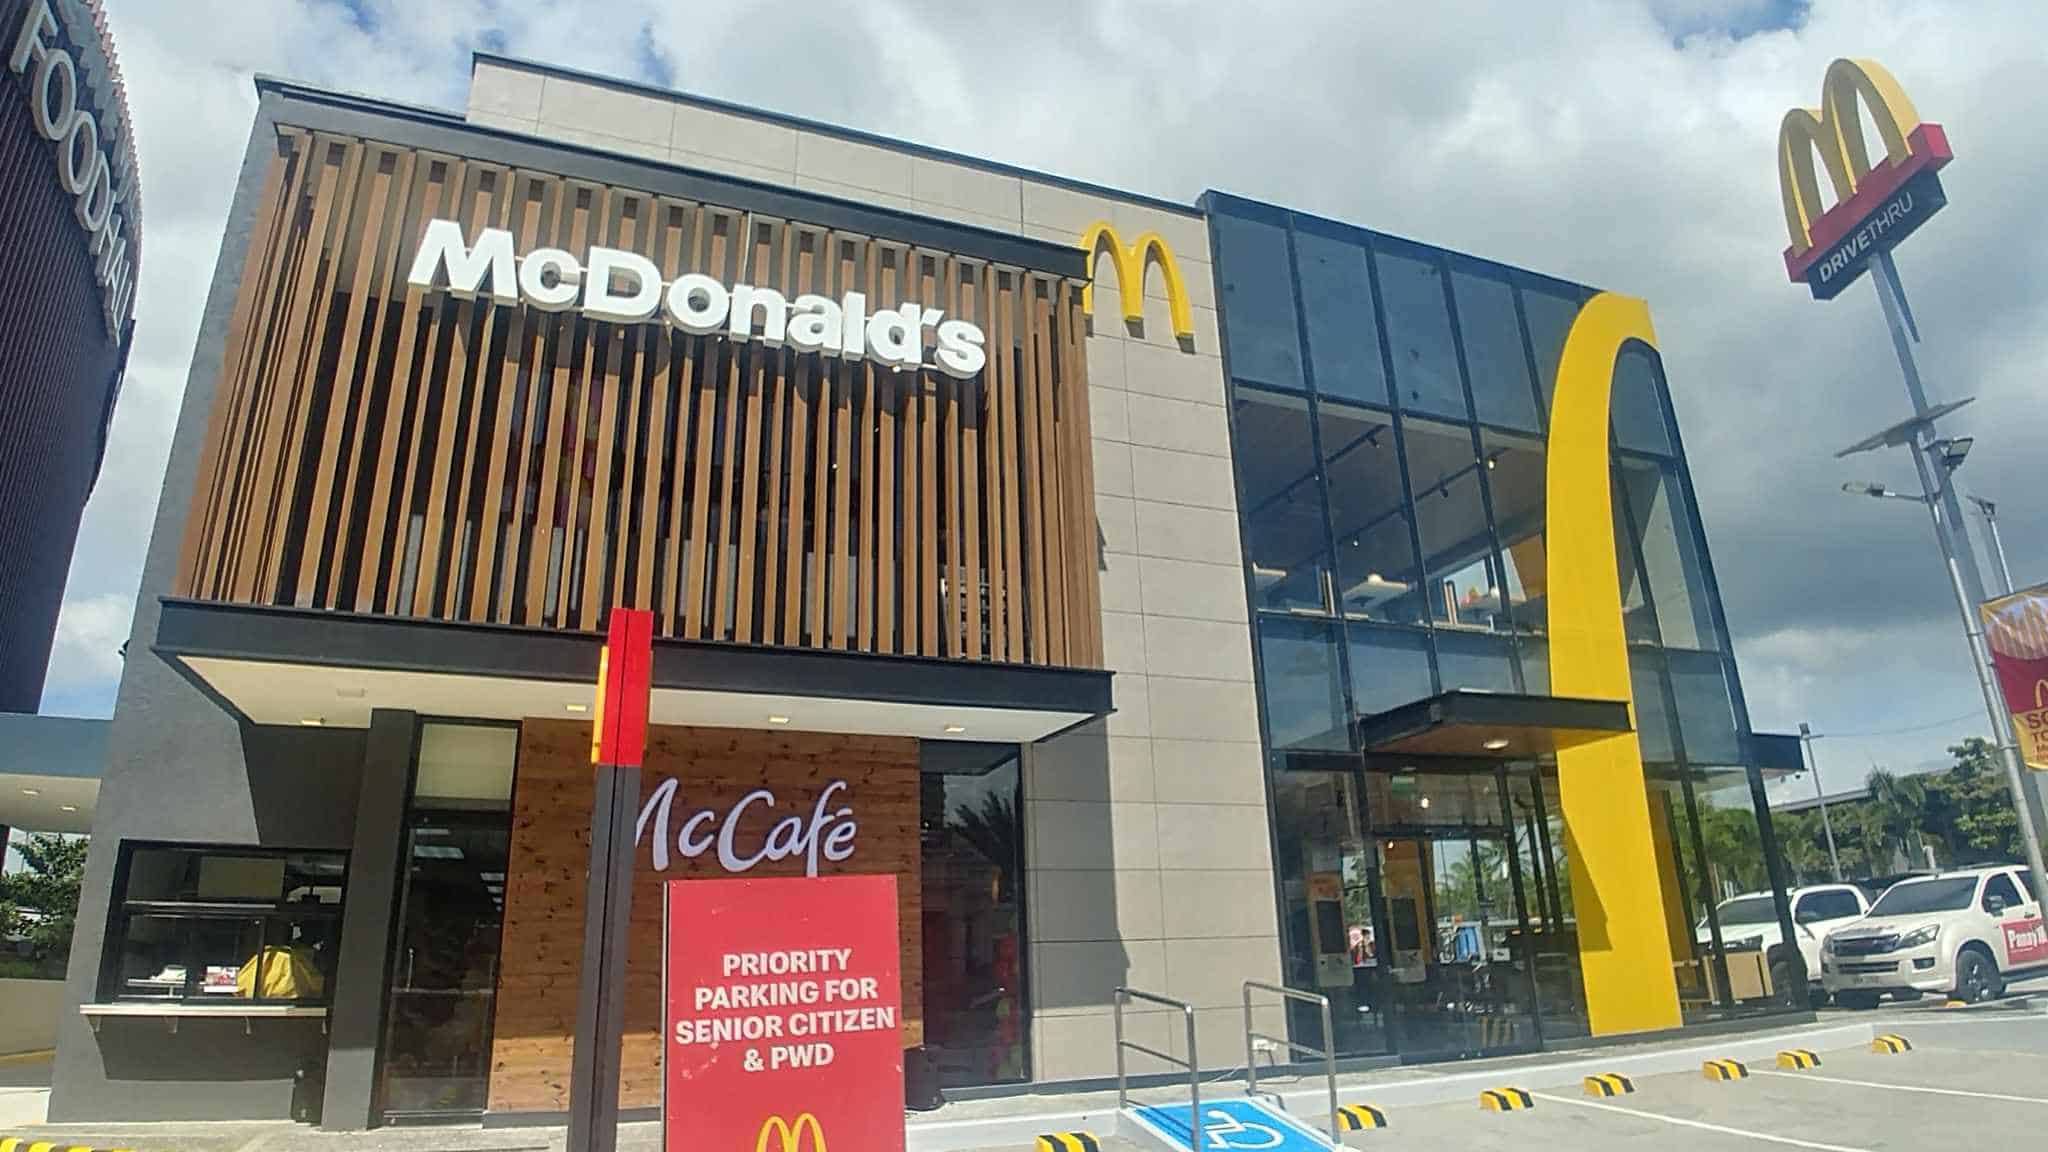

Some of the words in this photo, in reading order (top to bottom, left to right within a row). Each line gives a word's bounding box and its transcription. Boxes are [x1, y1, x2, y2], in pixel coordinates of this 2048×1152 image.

[407, 217, 986, 379] McDonald's
[722, 948, 852, 977] PRIORITY
[695, 980, 819, 1011] PARKING
[825, 977, 878, 1002] FOR
[675, 1013, 784, 1045] SENIOR
[788, 1006, 896, 1037] CITIZEN
[743, 1047, 764, 1073] &
[770, 1043, 834, 1070] PWD
